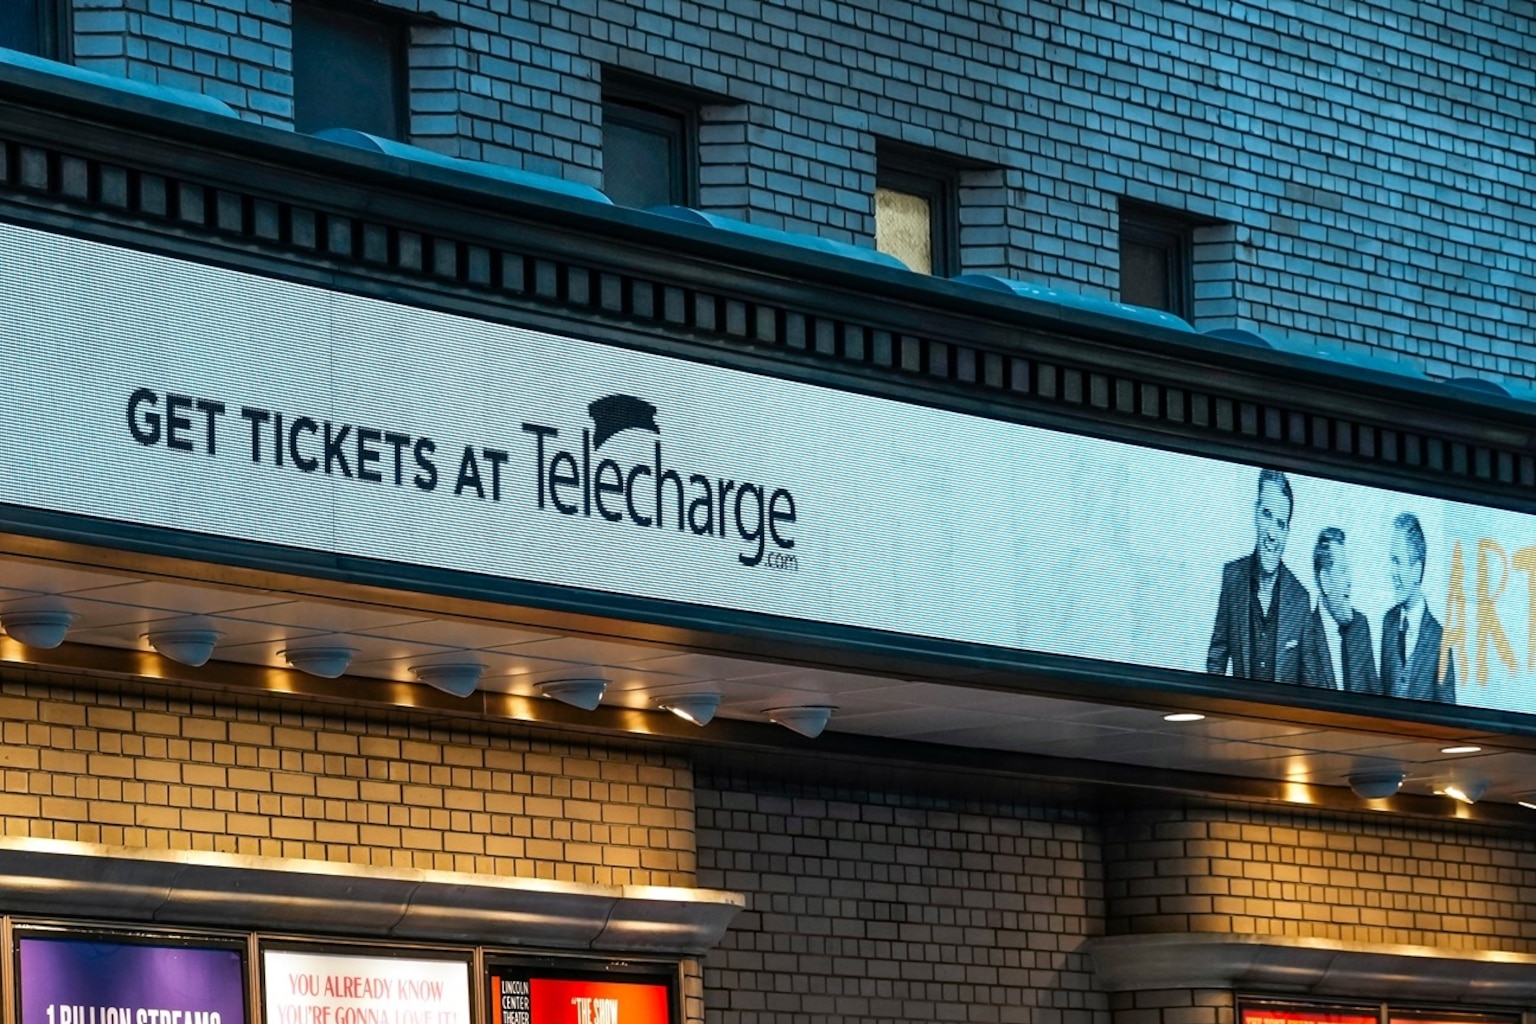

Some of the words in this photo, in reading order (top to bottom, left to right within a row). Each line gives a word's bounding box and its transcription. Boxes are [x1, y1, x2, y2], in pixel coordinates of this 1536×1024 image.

[127, 387, 225, 455] GET
[241, 406, 437, 491] TICKETS
[454, 446, 509, 501] AT
[522, 422, 797, 566] Telecharge
[766, 553, 799, 572] .com
[289, 974, 320, 996] YOU
[325, 976, 392, 999] ALREADY
[397, 979, 444, 1002] KNOW
[502, 981, 529, 994] LINCOLN
[502, 996, 529, 1010] CENTER
[503, 1011, 529, 1024] THEATER
